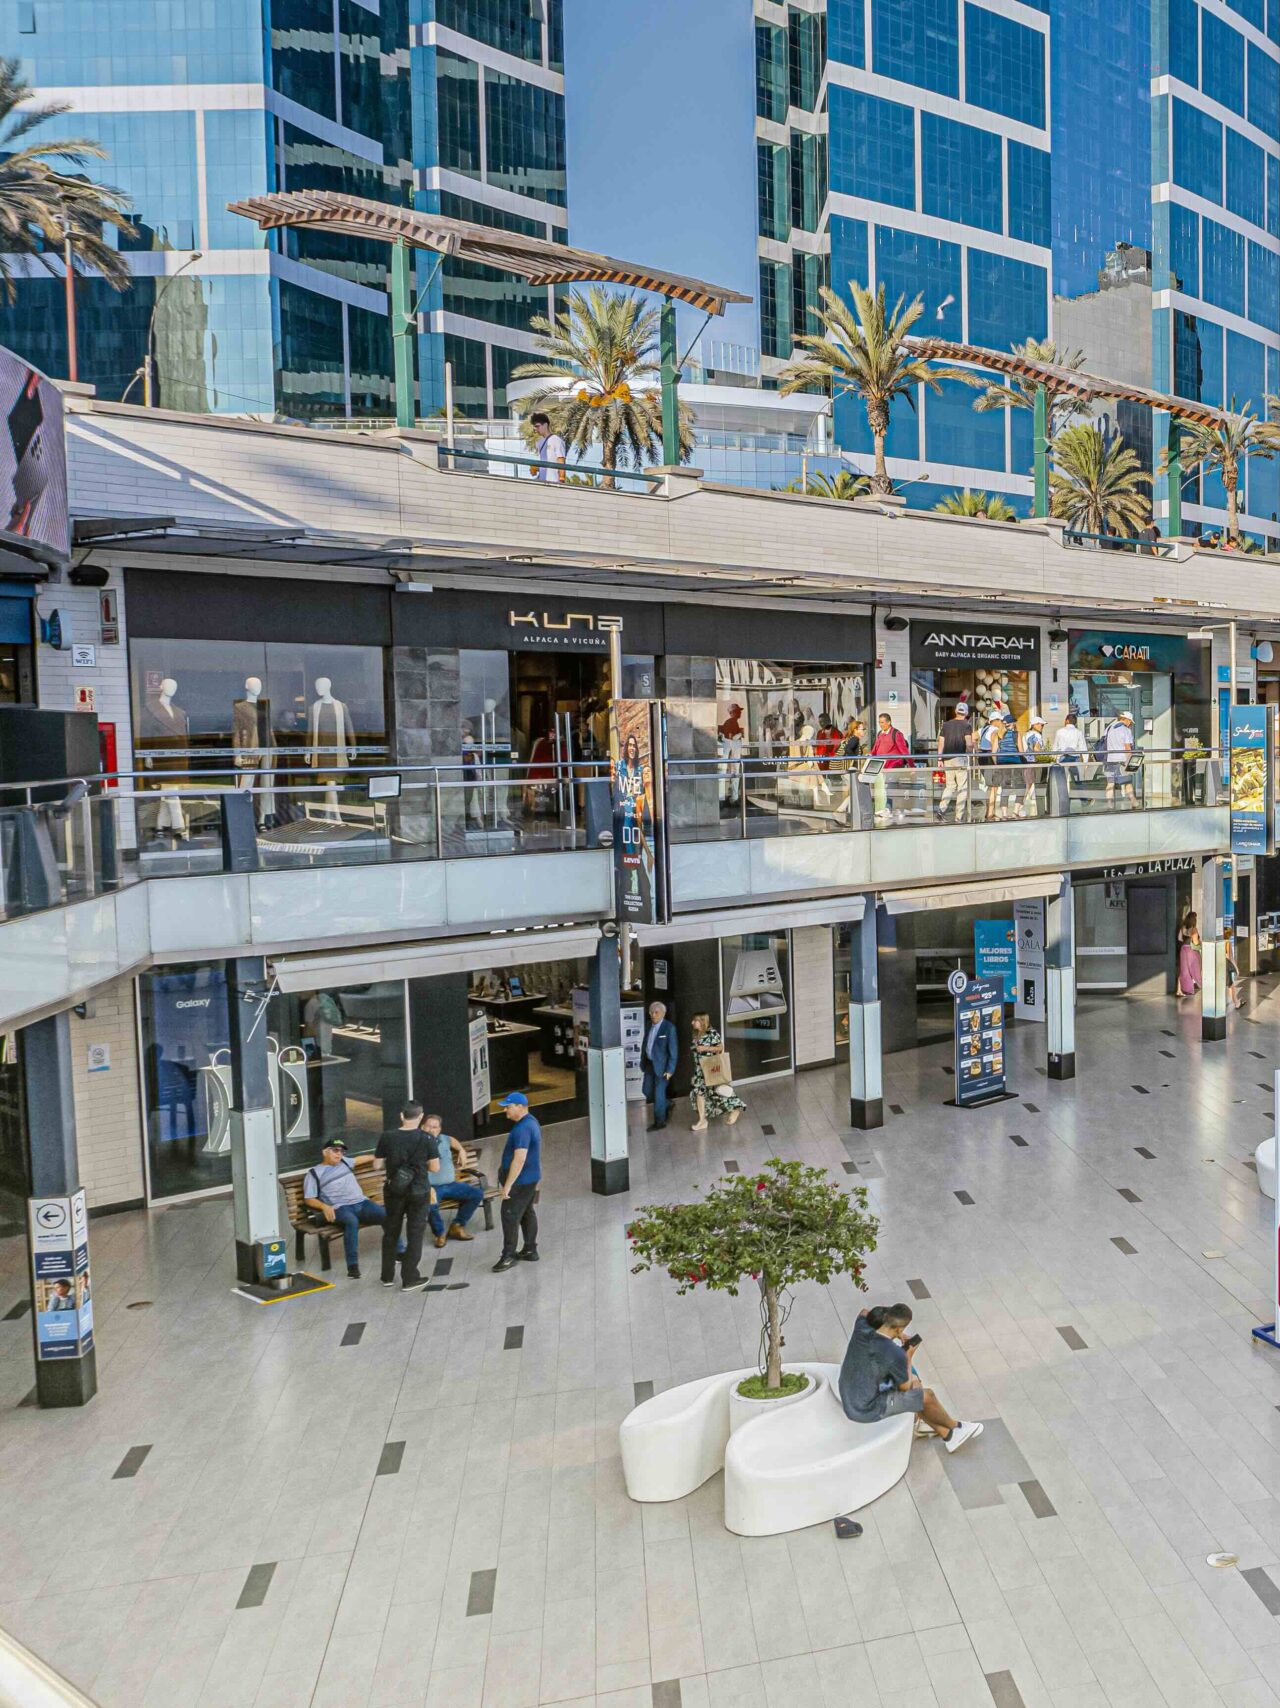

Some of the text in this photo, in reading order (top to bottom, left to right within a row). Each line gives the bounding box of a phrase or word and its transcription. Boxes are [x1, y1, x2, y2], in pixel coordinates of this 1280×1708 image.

[523, 635, 559, 643] ALPACA
[572, 637, 606, 645] VICUÑA
[924, 632, 1034, 650] ANNTARAH
[1114, 645, 1150, 660] CARATI
[618, 776, 642, 795] WE
[1148, 861, 1161, 873] LA
[1164, 856, 1196, 872] PLAZA
[1017, 939, 1040, 950] QALA
[176, 998, 211, 1009] Galaxy
